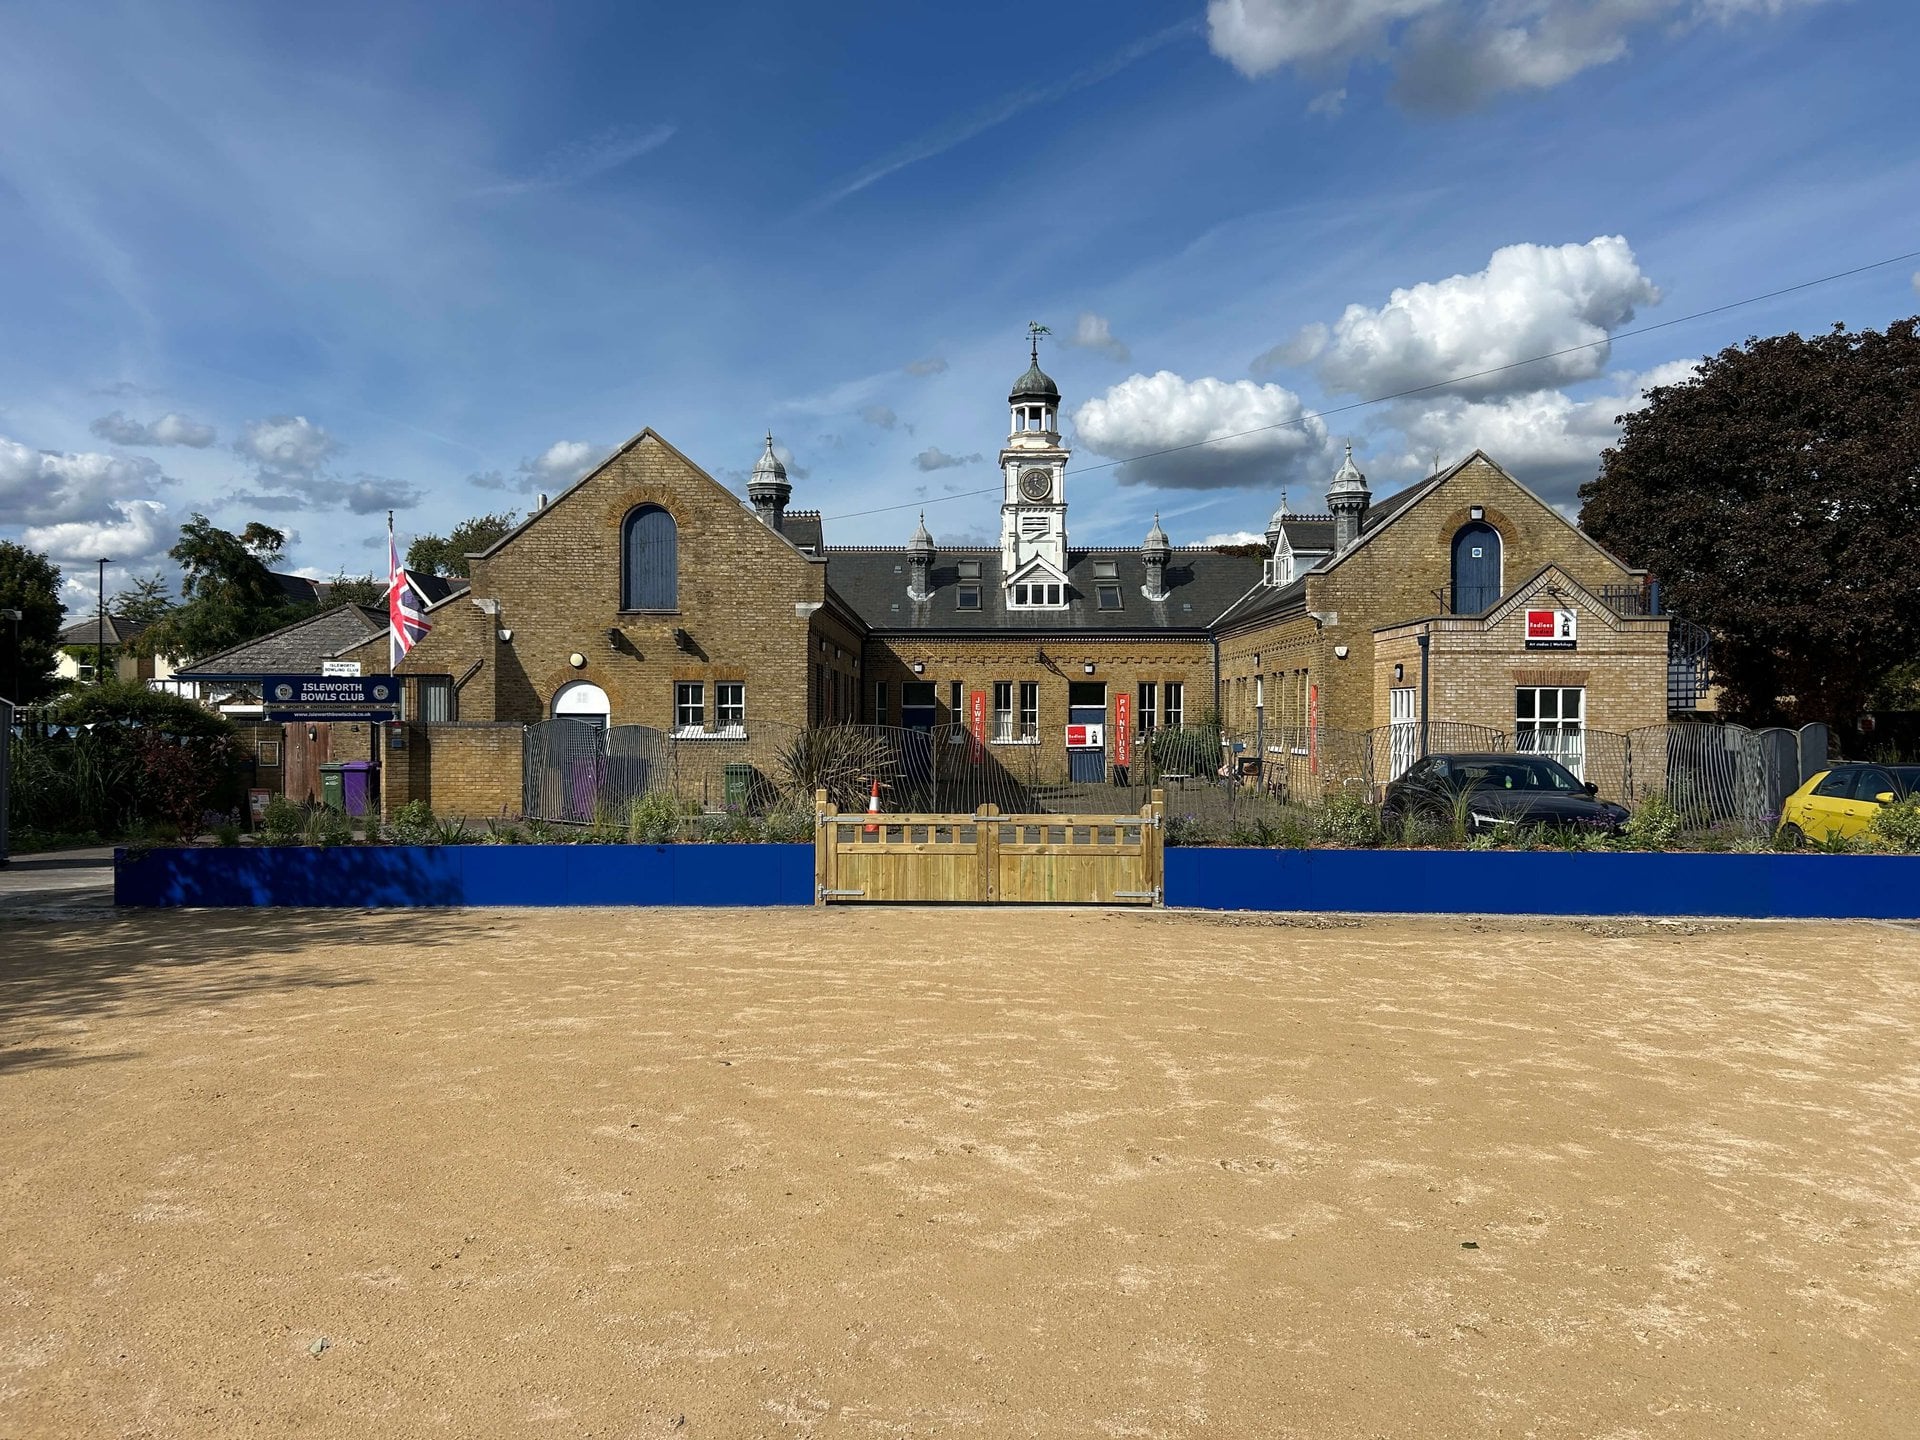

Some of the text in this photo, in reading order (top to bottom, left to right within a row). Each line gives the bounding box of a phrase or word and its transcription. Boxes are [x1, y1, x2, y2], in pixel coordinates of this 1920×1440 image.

[302, 683, 362, 691] ISLEWORTH
[300, 693, 365, 701] BOWLS CLUB
